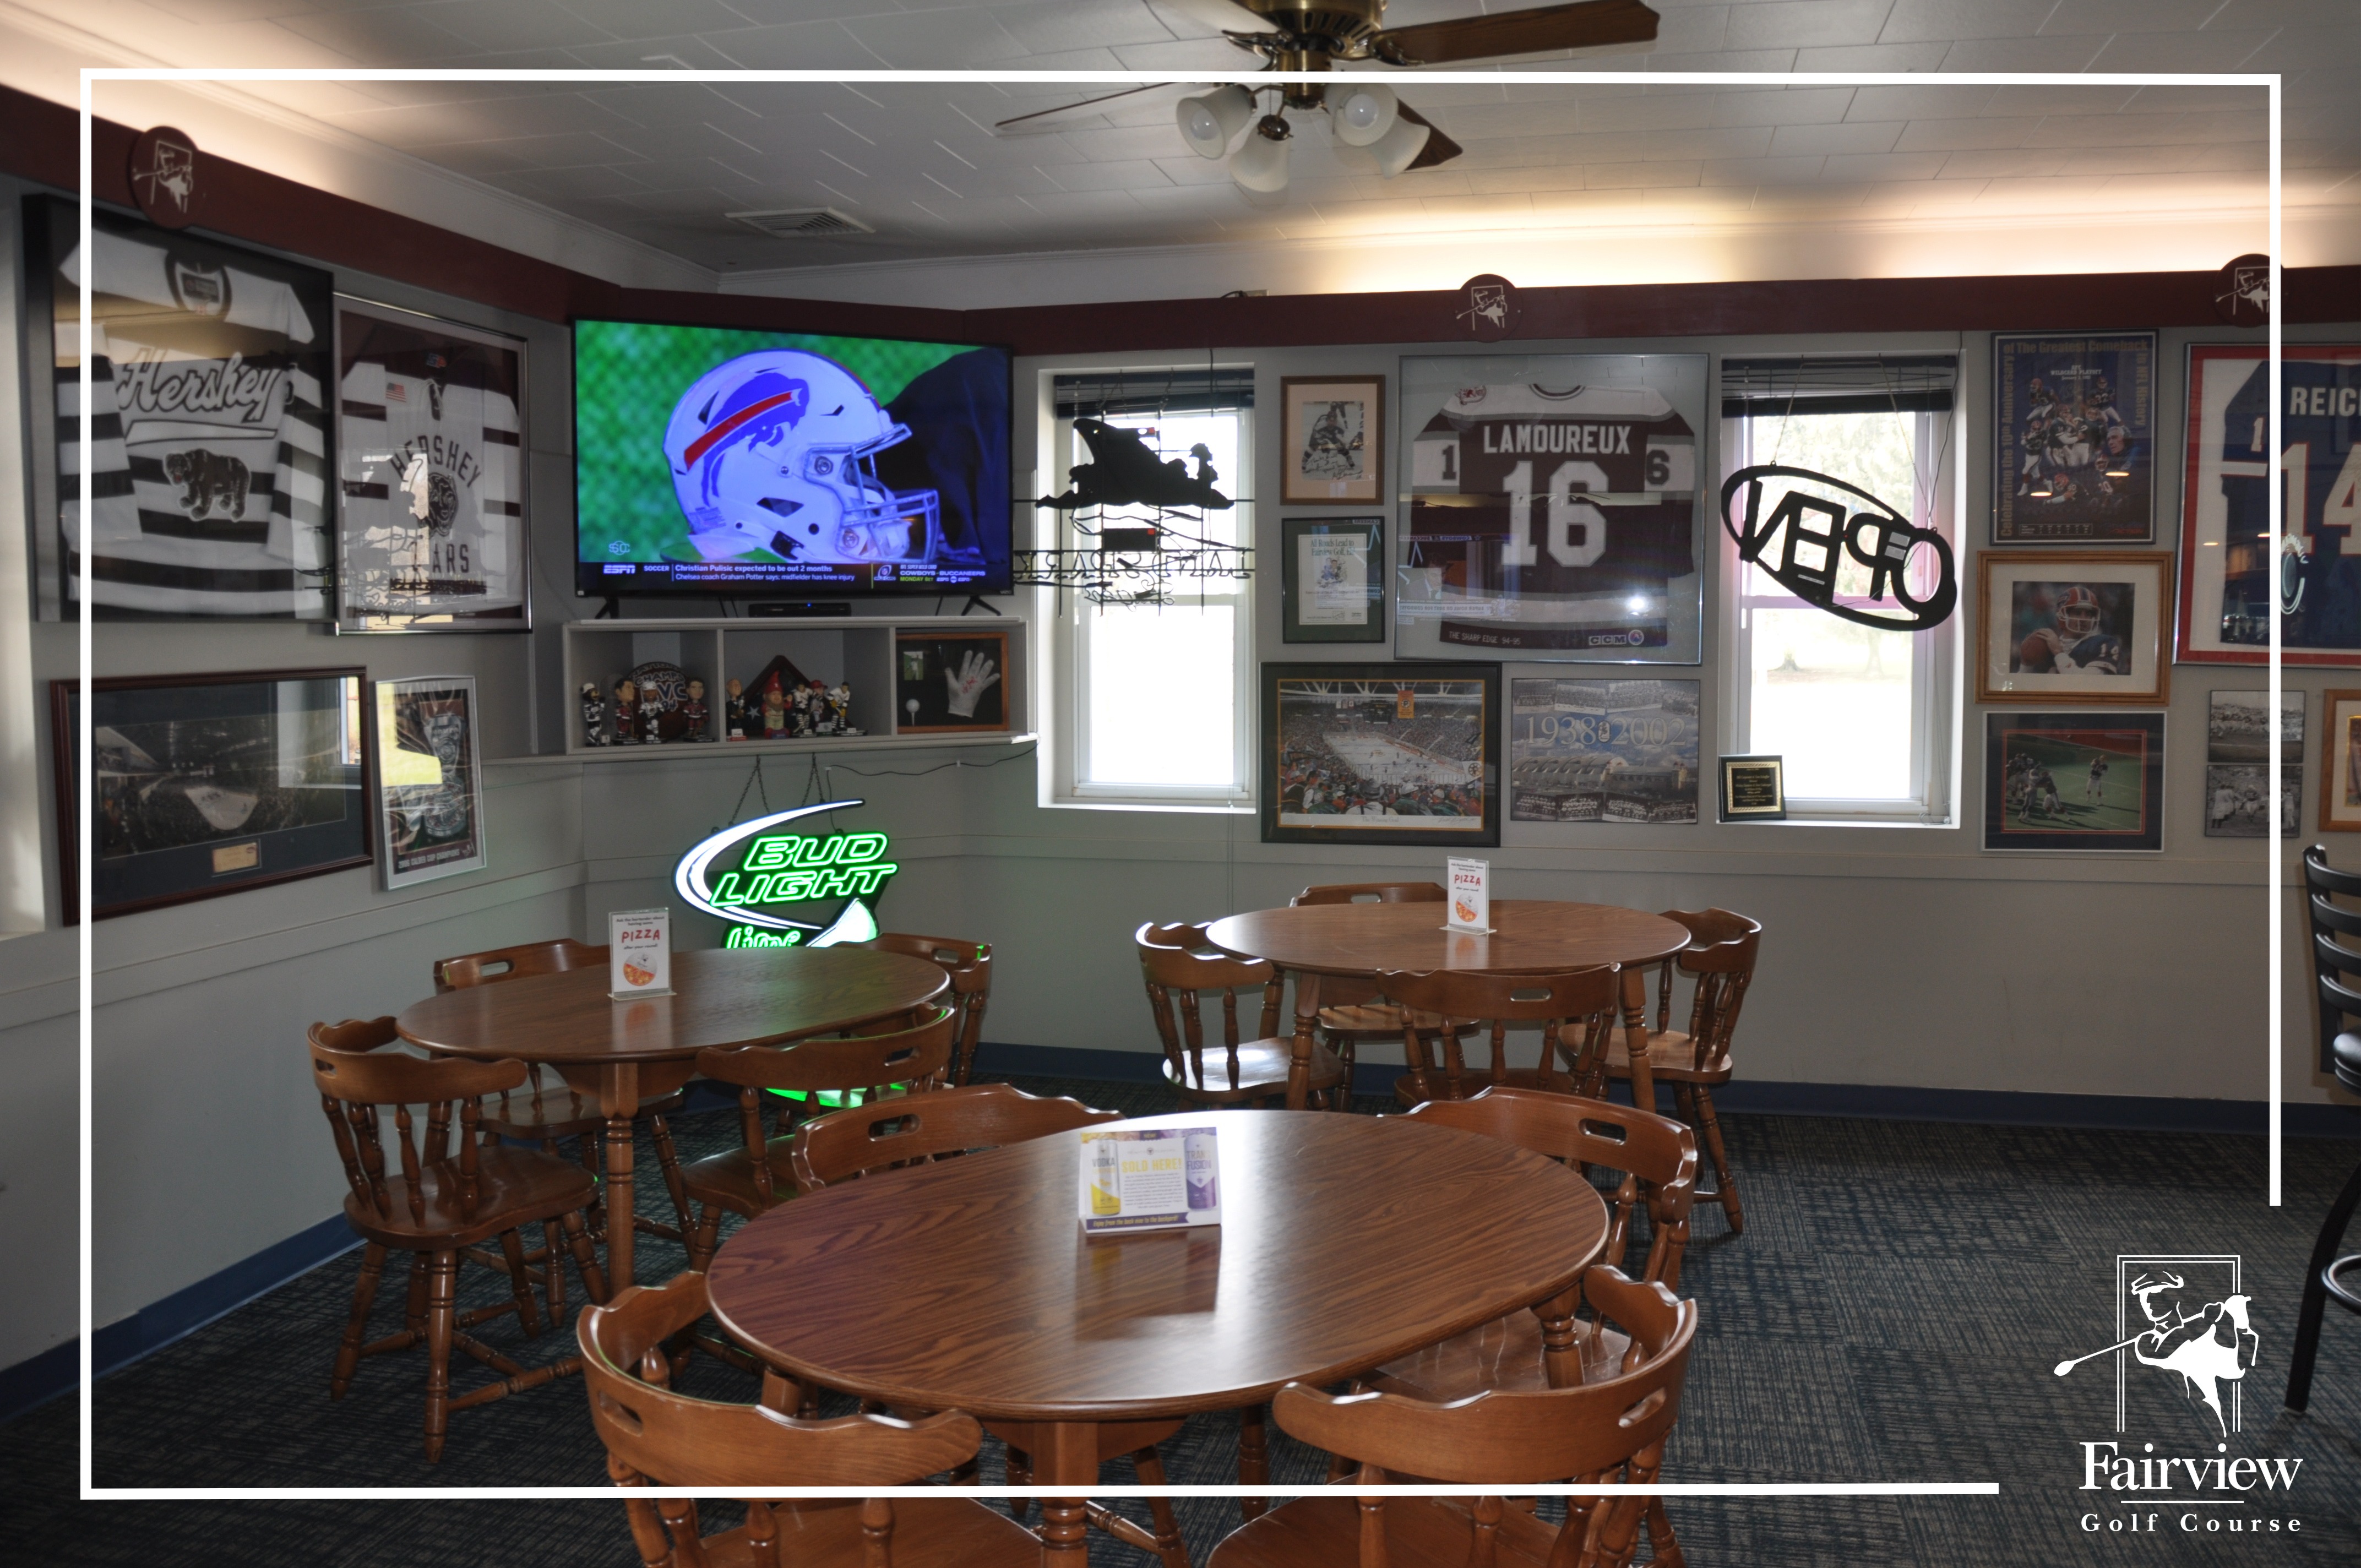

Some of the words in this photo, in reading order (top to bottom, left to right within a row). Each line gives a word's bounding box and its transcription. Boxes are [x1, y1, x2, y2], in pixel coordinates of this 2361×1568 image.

[2004, 342, 2014, 353] of
[2016, 342, 2036, 353] The
[2039, 341, 2086, 353] Greatest
[2088, 339, 2147, 352] Comeback
[115, 347, 282, 423] Hershey
[2001, 356, 2014, 424] Anniversary
[2289, 386, 2361, 417] REIC
[1484, 425, 1631, 454] LAMOUREUX
[2250, 416, 2266, 452] 1
[1441, 444, 1457, 481] 1
[2001, 449, 2013, 467] the
[1645, 449, 1670, 486] 6
[2000, 470, 2014, 537] Celebrating
[1502, 460, 1609, 567] 16
[1336, 538, 1347, 547] Lead
[603, 565, 635, 574] ESPN
[735, 565, 766, 573] expected
[1449, 631, 1460, 639] THE
[1462, 633, 1482, 642] SHARP
[1482, 635, 1498, 644] EDGE
[1502, 637, 1521, 645] 94-95
[1588, 635, 1627, 646] CCM
[634, 671, 685, 688] CHAMPS
[1526, 716, 1597, 745] 1938
[1611, 716, 1686, 746] 2002
[744, 832, 889, 870] BUD
[710, 862, 900, 908] LIGHT
[1454, 874, 1481, 886] PIZZA
[621, 929, 660, 943] PIZZA
[1092, 1157, 1116, 1167] VODKA
[1121, 1159, 1149, 1173] SOLD
[1152, 1158, 1183, 1171] HERE!
[1187, 1159, 1211, 1170] FUSION
